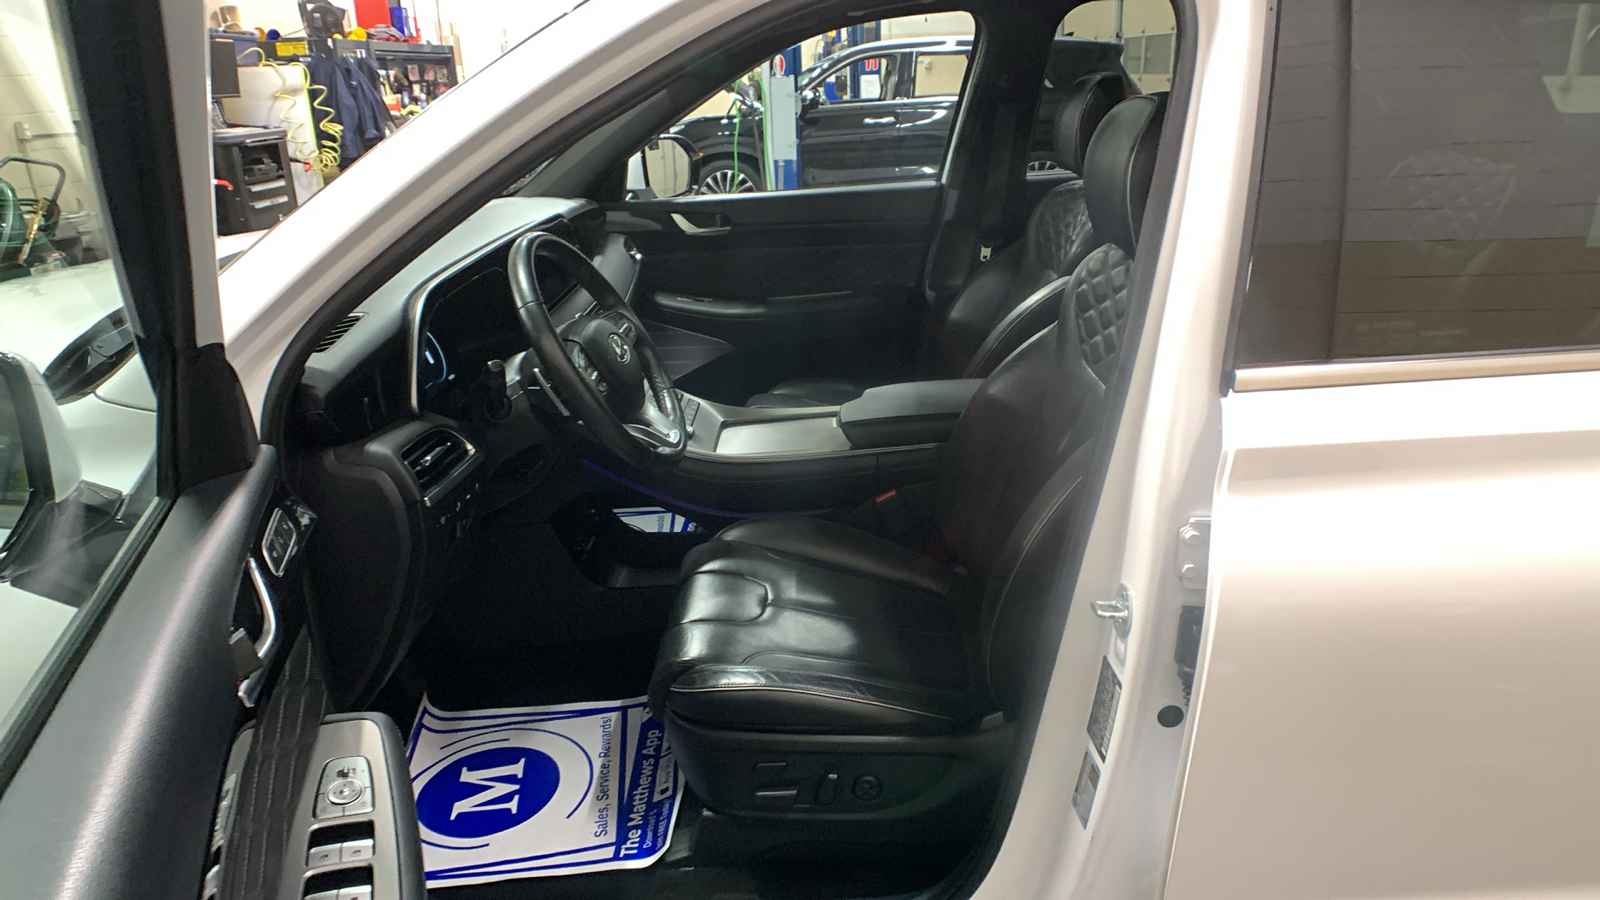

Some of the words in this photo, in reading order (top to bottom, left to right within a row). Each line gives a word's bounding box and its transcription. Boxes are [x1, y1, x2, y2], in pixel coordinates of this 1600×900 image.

[598, 716, 612, 759] Rewards!
[642, 729, 663, 755] App
[450, 757, 526, 821] M
[596, 760, 613, 802] Service,
[627, 758, 655, 827] Matthews
[594, 803, 612, 838] Sales,
[619, 829, 642, 858] The
